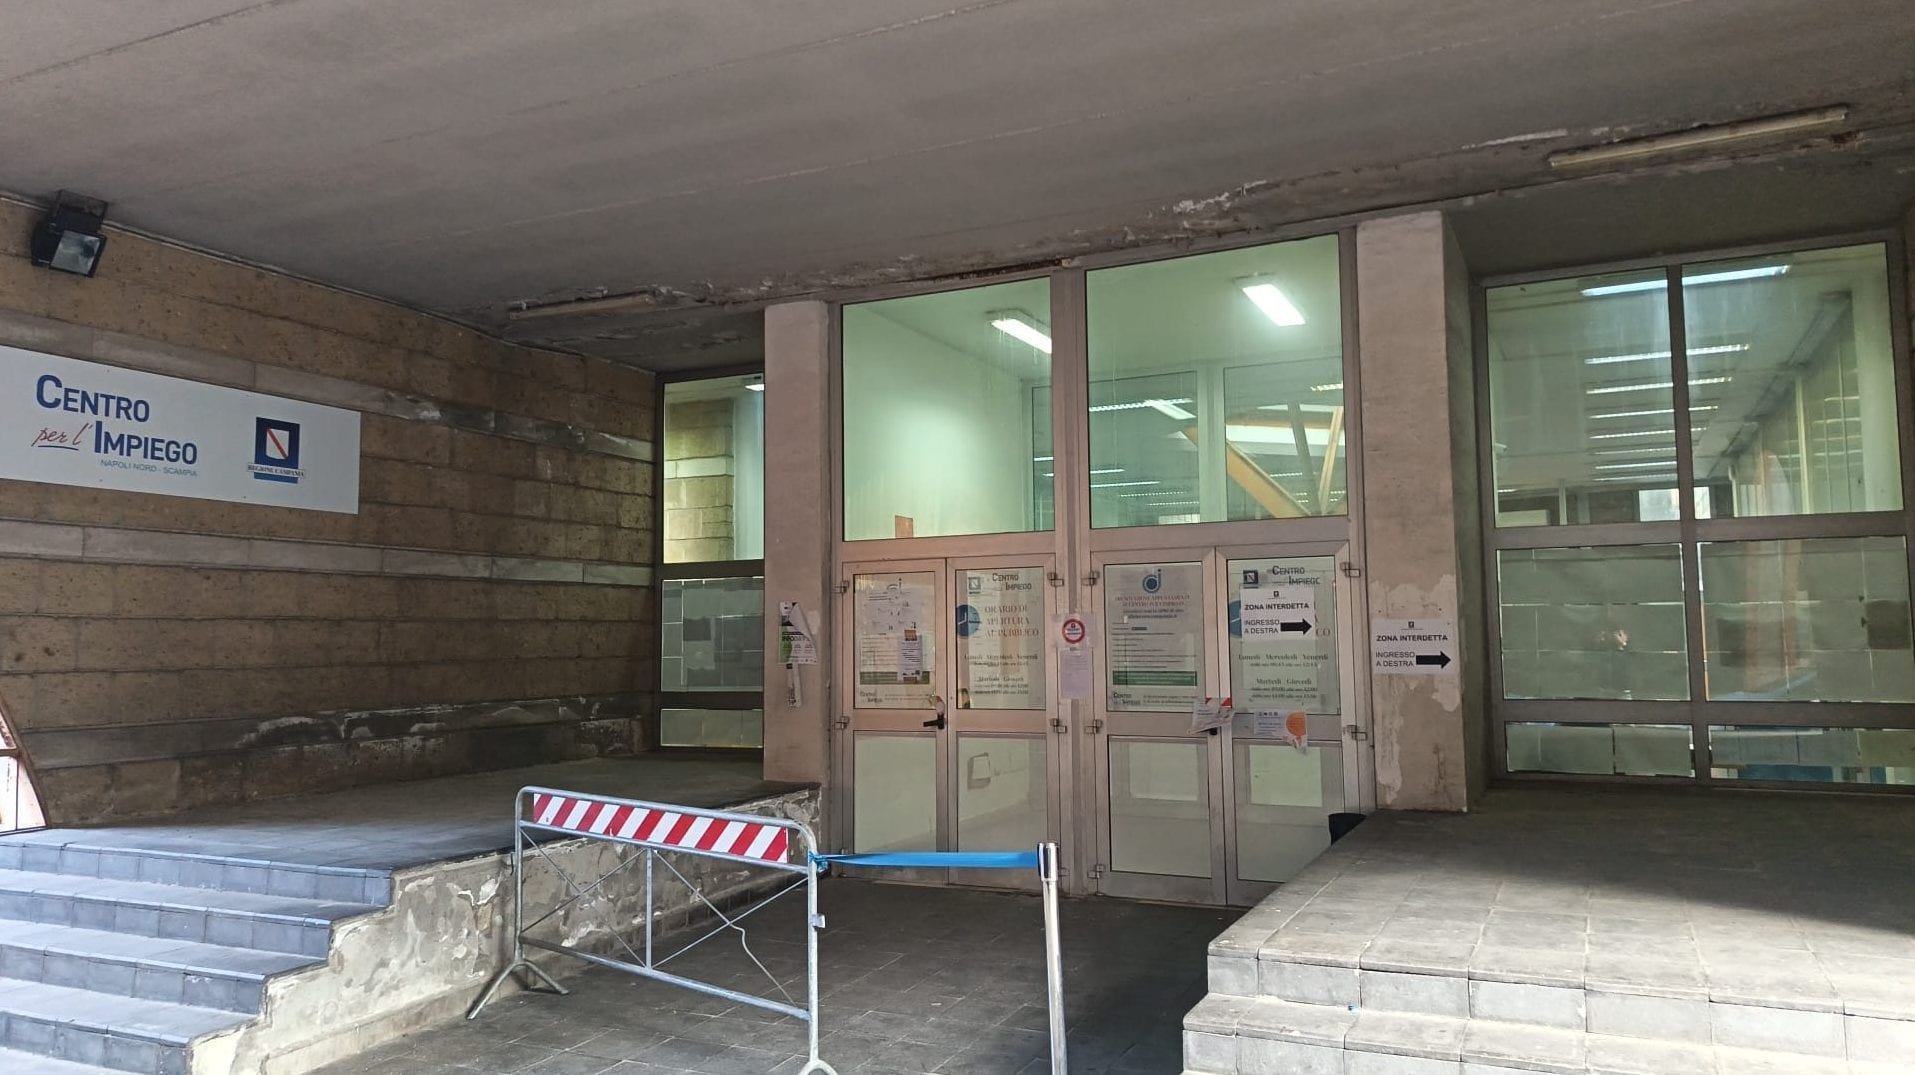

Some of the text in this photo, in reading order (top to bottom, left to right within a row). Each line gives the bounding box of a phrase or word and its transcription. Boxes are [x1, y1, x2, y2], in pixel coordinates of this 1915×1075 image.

[36, 374, 150, 423] CENTRO
[31, 427, 68, 447] per
[94, 420, 198, 465] IMPIEGO
[101, 459, 132, 470] NAPOLI
[133, 463, 157, 472] NORD
[1271, 565, 1305, 575] CENTRO
[992, 573, 1019, 582] CENTRO
[1005, 582, 1032, 591] IMPIEGO
[1265, 602, 1310, 611] INTERDETTA
[1250, 627, 1279, 635] DESTRA
[1375, 651, 1415, 659] INGRESSO
